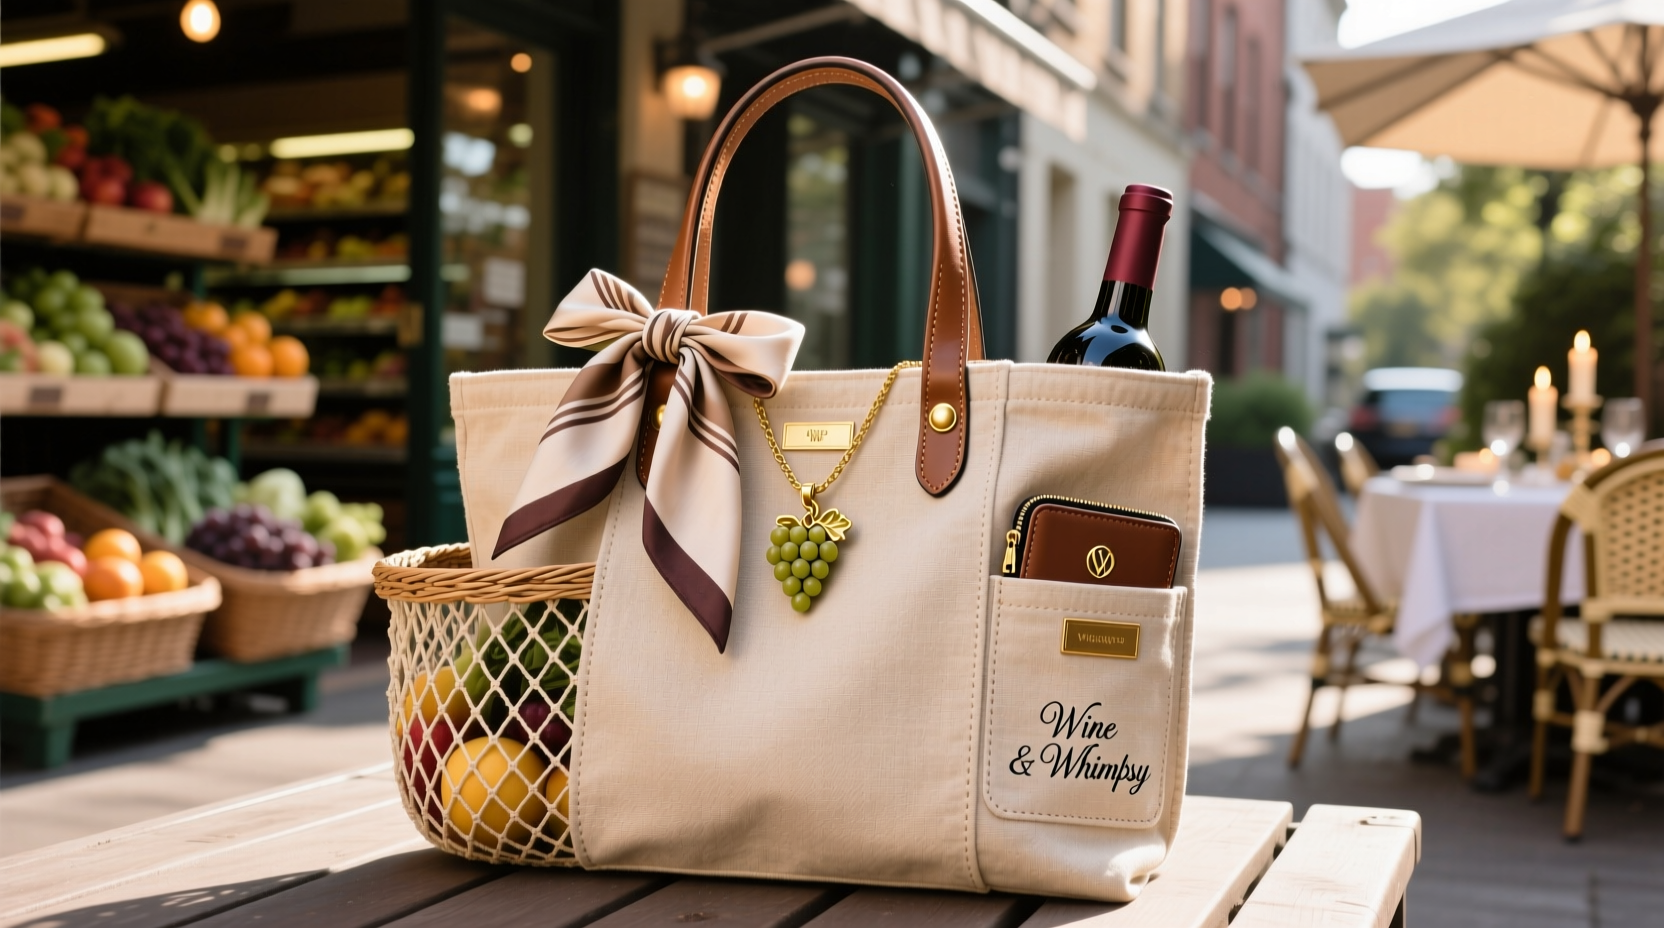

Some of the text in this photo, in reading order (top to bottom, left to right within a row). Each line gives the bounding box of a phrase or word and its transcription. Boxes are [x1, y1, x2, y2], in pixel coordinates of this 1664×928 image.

[1040, 701, 1118, 740] Wine
[1009, 743, 1151, 795] & Whimpsy
